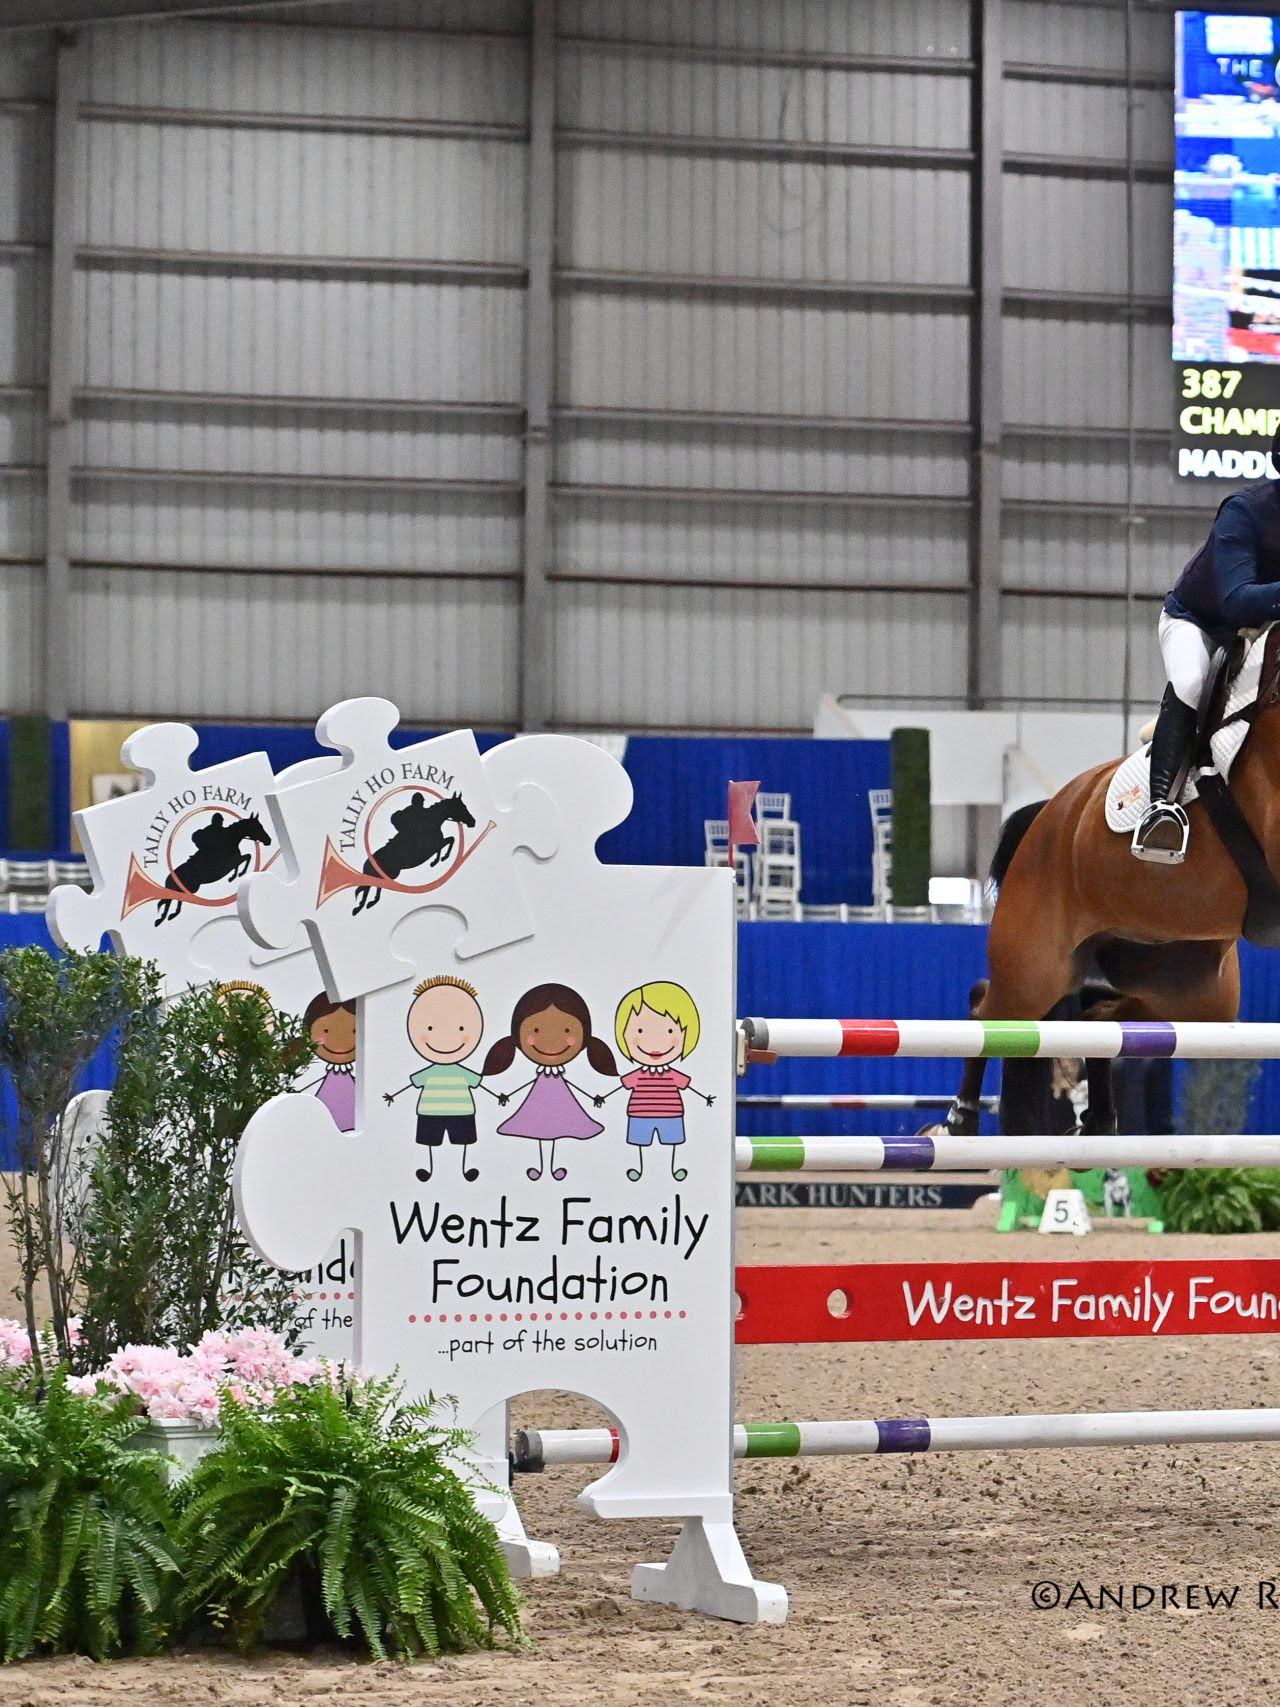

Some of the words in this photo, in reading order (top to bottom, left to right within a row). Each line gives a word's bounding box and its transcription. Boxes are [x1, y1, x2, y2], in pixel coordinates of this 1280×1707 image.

[1216, 57, 1264, 78] THE
[1181, 368, 1242, 399] 387
[339, 791, 368, 852] TALLY
[364, 767, 396, 795] HO
[401, 763, 456, 790] FARM
[143, 807, 173, 868] TALLY
[168, 789, 197, 814] HO
[202, 784, 253, 811] FARM
[808, 1184, 944, 1207] HUNTERS
[389, 1196, 540, 1249] Wentz
[561, 1194, 709, 1261] Family
[1054, 1200, 1069, 1224] 5
[432, 1255, 668, 1304] Foundation
[322, 1308, 353, 1330] the
[902, 1277, 1036, 1326] Wentz
[1051, 1275, 1175, 1333] Family
[503, 1329, 528, 1352] of
[532, 1329, 566, 1353] the
[574, 1329, 658, 1352] solution
